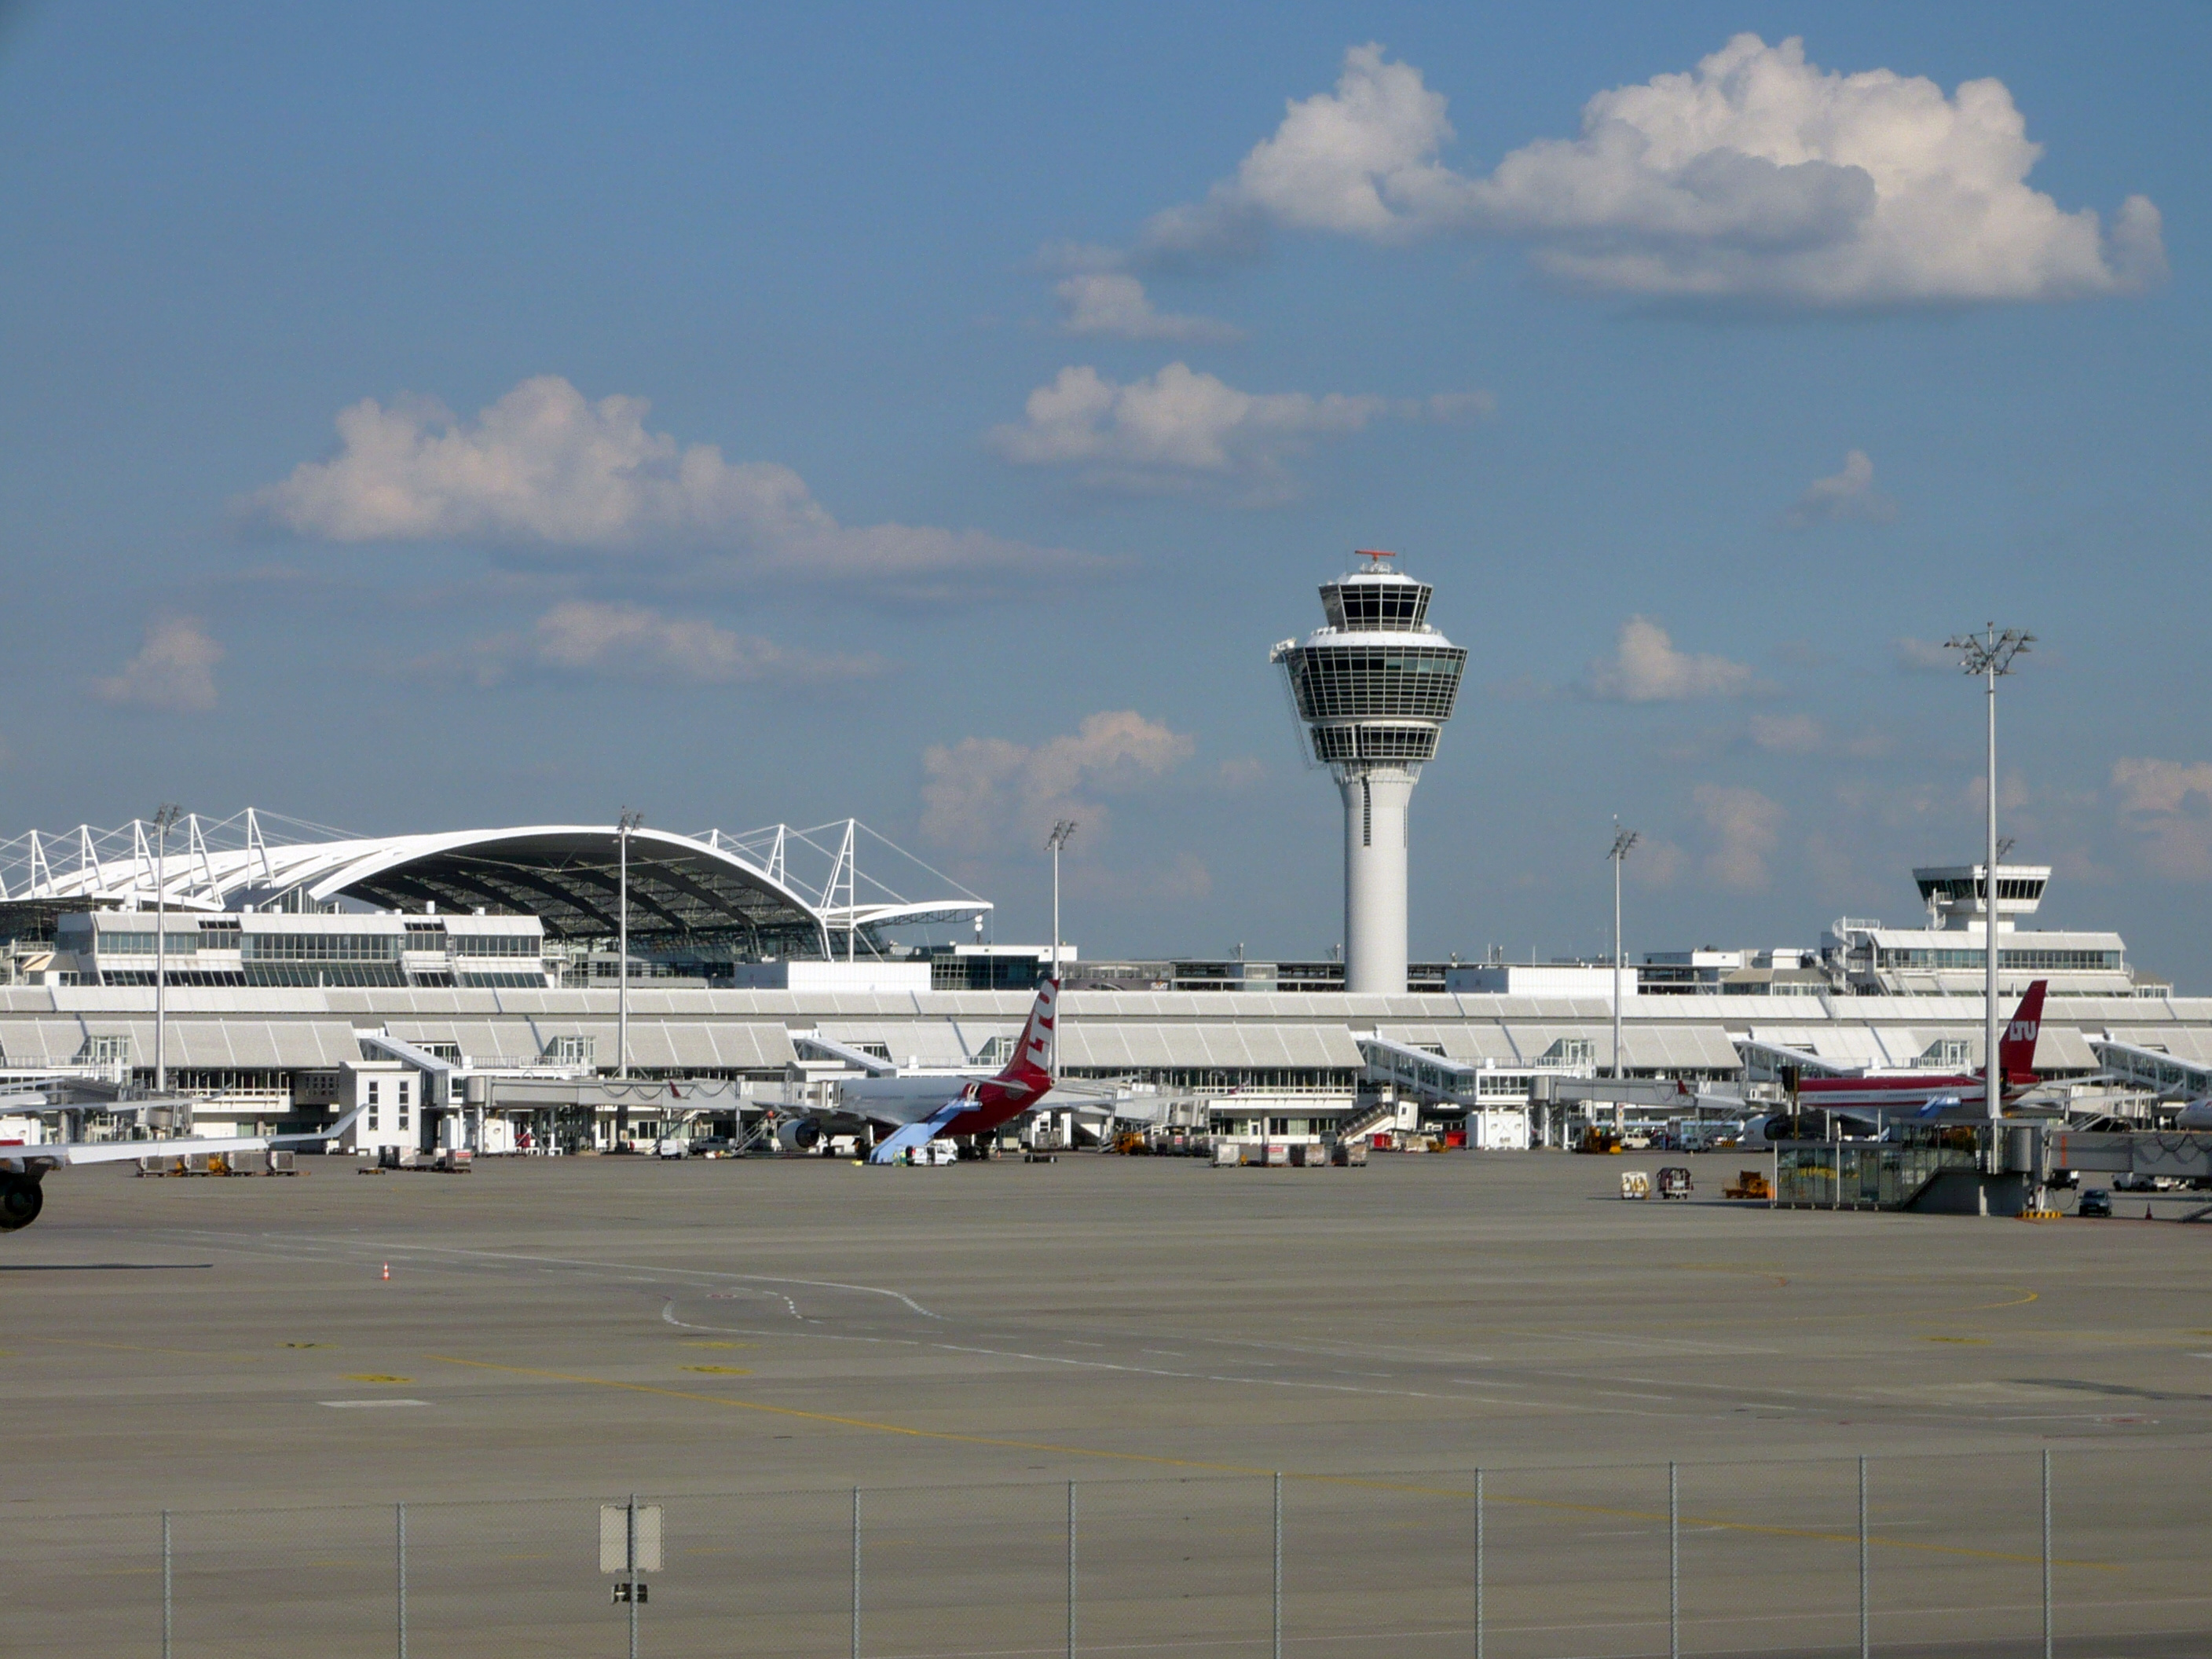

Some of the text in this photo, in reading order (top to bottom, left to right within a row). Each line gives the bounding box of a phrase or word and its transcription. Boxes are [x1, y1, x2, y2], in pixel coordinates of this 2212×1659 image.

[1026, 979, 1057, 1071] LTU
[2010, 1020, 2037, 1041] LTU
[740, 1082, 753, 1095] M
[1699, 1081, 1711, 1093] M
